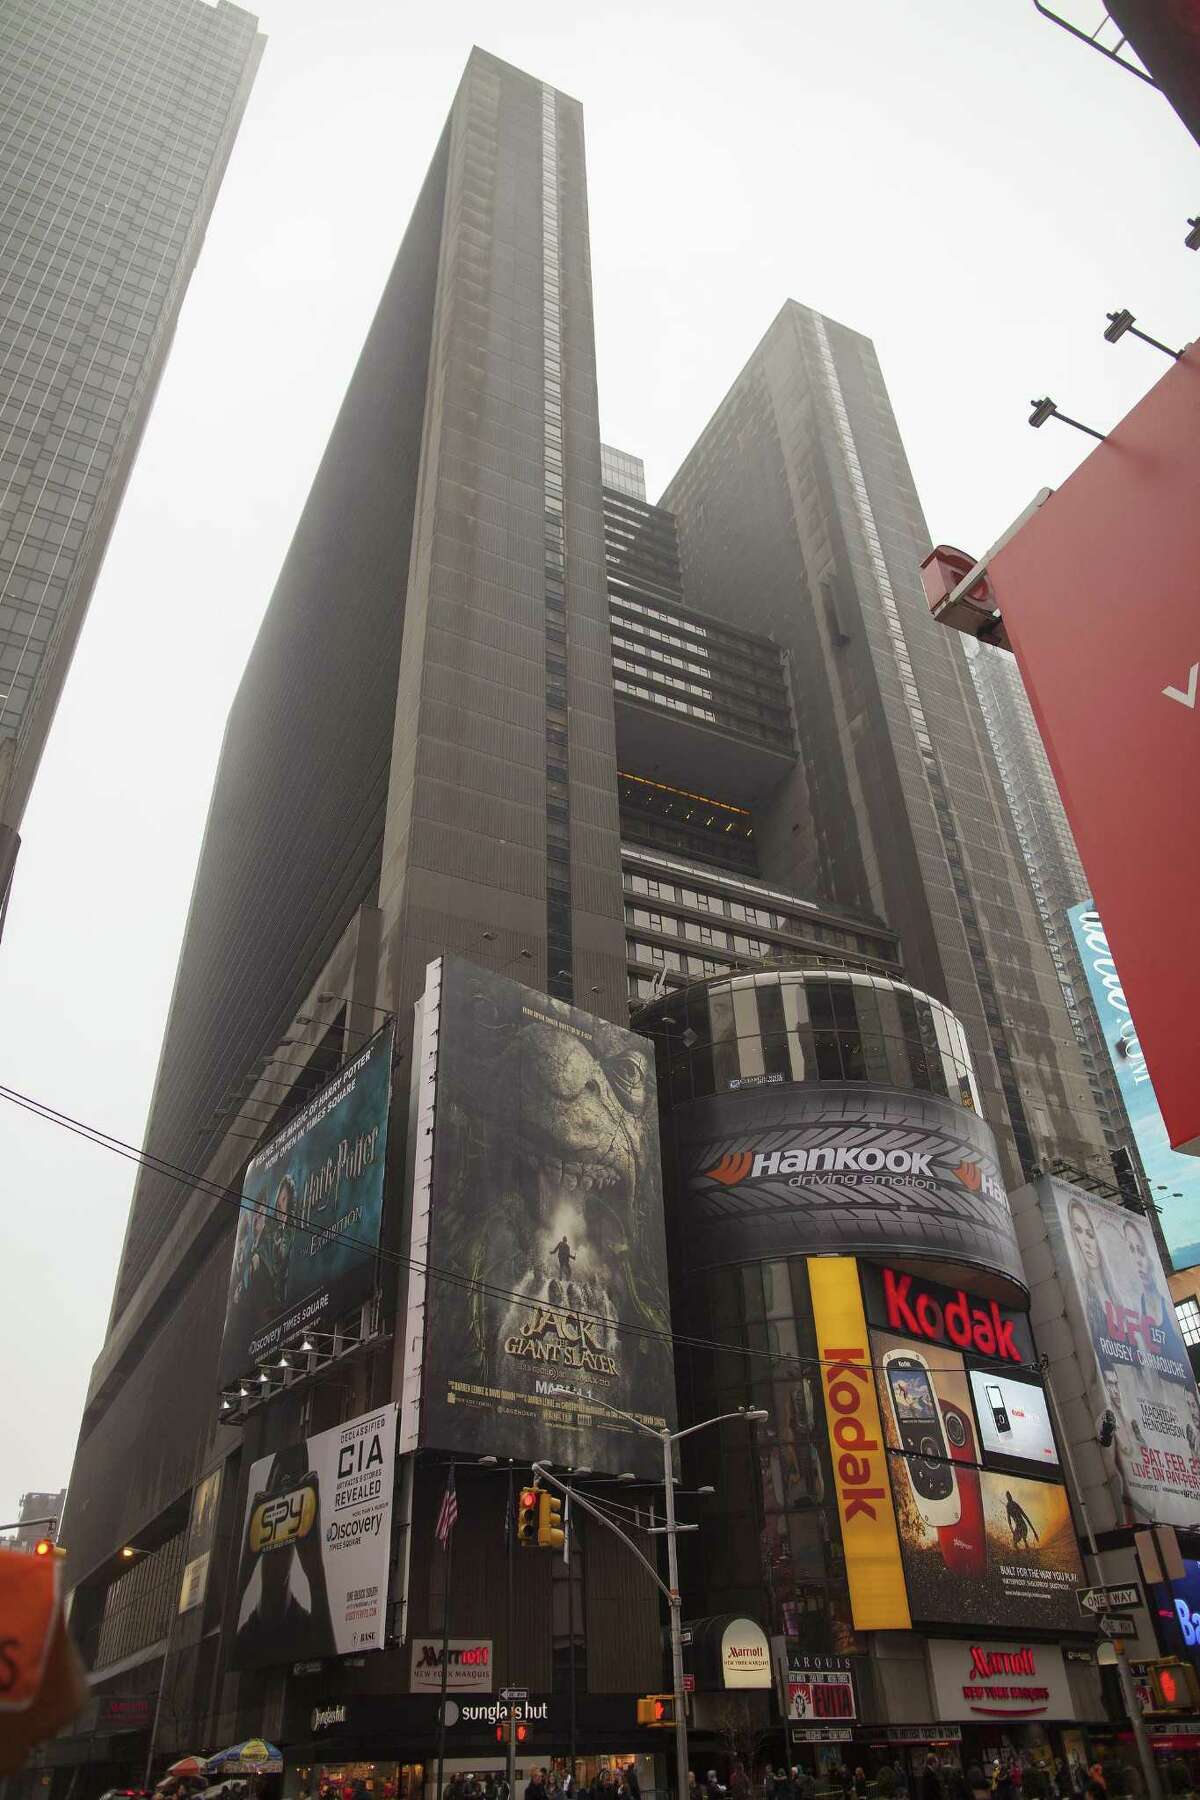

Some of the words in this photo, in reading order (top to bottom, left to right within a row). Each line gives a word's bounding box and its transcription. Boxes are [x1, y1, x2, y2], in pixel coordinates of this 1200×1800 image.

[287, 1110, 308, 1136] MAGIC
[318, 1076, 342, 1106] HARRY
[343, 1050, 371, 1082] POTTER
[279, 1137, 297, 1157] OPEN
[306, 1110, 327, 1134] TIMES
[327, 1079, 357, 1113] SQUARE
[788, 1171, 861, 1189] driving
[862, 1171, 938, 1191] emotion
[282, 1312, 301, 1334] TIMES
[302, 1294, 329, 1321] SQUARE
[519, 1305, 607, 1351] JACK
[883, 1267, 1023, 1363] Kodak
[1105, 1301, 1162, 1355] UFC
[1151, 1327, 1167, 1344] 157
[504, 1336, 562, 1361] GIANT
[564, 1347, 621, 1376] SLAYER
[1099, 1336, 1133, 1362] ROUSEY
[1136, 1349, 1187, 1379] CARMOUCHE
[340, 1417, 385, 1444] DECLASSIFIED
[824, 1348, 886, 1523] Kodak
[337, 1433, 384, 1479] CIA
[1164, 1452, 1189, 1473] FEB.
[363, 1468, 382, 1481] STORIES
[1131, 1462, 1150, 1479] LIVE
[1151, 1467, 1165, 1481] ON
[335, 1479, 381, 1507] REVEALED
[260, 1494, 304, 1544] SPY
[330, 1512, 383, 1542] Discovery
[1000, 1565, 1016, 1576] BUILT
[1016, 1567, 1027, 1577] FOR
[1028, 1568, 1039, 1579] THE
[1039, 1569, 1052, 1580] WAY
[1052, 1571, 1064, 1581] YOU
[1088, 1593, 1104, 1608] ONE
[1112, 1591, 1132, 1603] WAY
[416, 1646, 488, 1668] Marriott
[728, 1647, 763, 1658] Marriott
[969, 1645, 1035, 1681] Marriott
[414, 1670, 431, 1678] NEW
[433, 1670, 453, 1679] YOK
[454, 1670, 490, 1679] MARQUIS
[962, 1686, 984, 1700] NEW
[984, 1686, 1009, 1700] YORK
[1010, 1687, 1050, 1703] MARQUIS
[525, 1701, 548, 1719] hut
